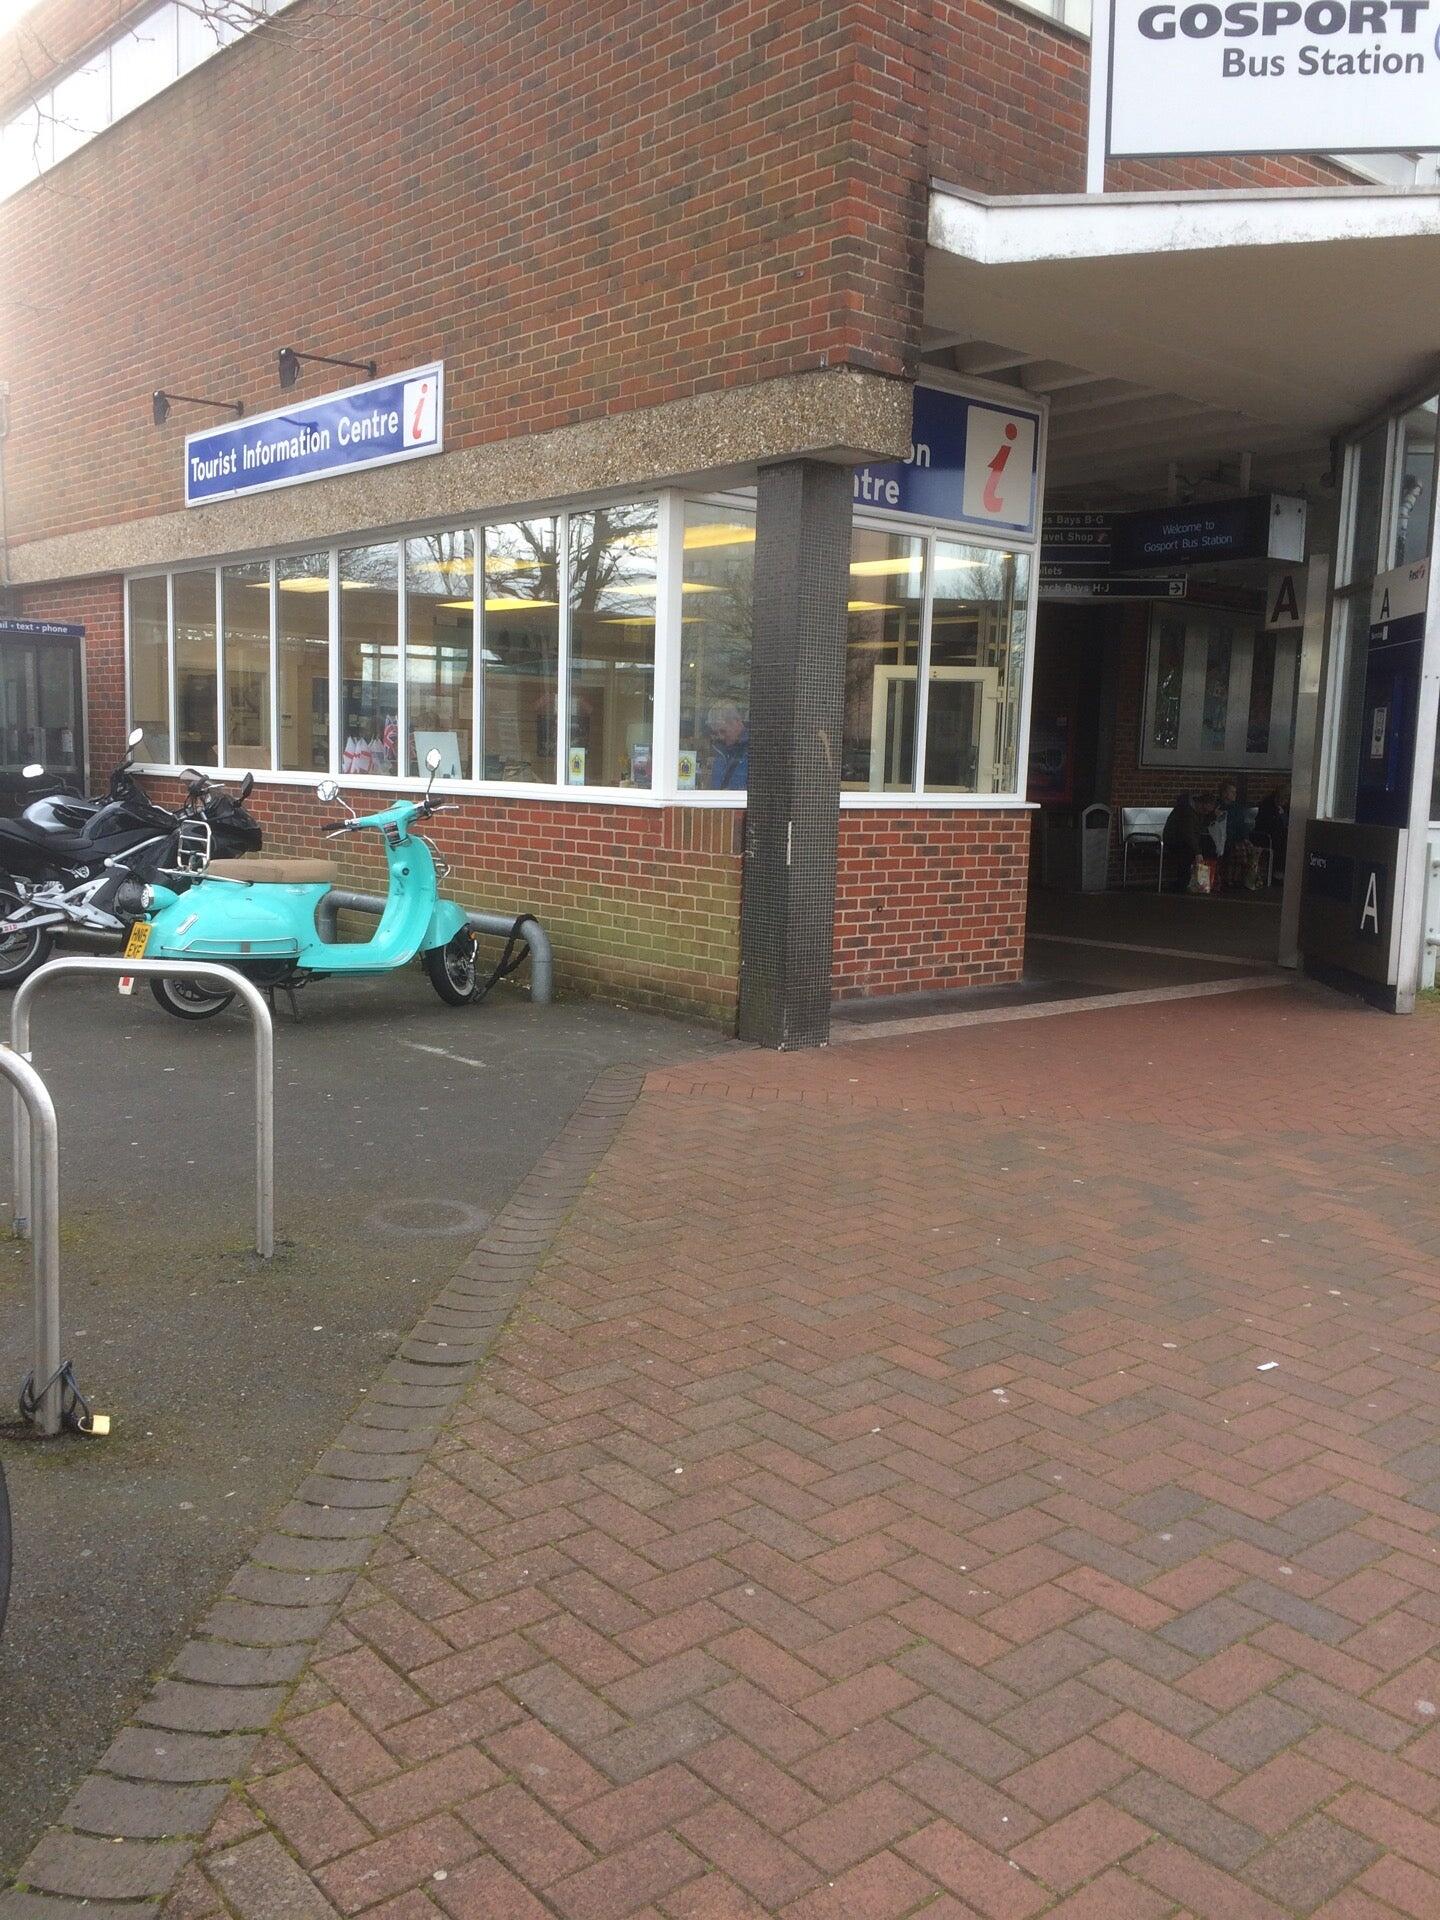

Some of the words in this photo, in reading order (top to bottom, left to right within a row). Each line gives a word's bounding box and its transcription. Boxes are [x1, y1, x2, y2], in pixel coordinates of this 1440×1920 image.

[1138, 0, 1430, 40] GOSPORT
[1222, 47, 1285, 77] Bus
[1298, 44, 1425, 76] Station
[190, 451, 237, 482] Tourist
[243, 427, 330, 470] Information
[338, 410, 399, 447] Centre
[1056, 515, 1081, 526] Bays
[1162, 523, 1202, 535] Welcome
[1205, 521, 1215, 530] to
[1067, 532, 1094, 543] Shop
[1144, 541, 1178, 553] Gosport
[1182, 538, 1198, 549] Bus
[1201, 535, 1233, 547] Station
[1039, 566, 1063, 575] ilets
[1270, 575, 1300, 622] A
[1380, 587, 1390, 620] A
[16, 622, 34, 631] text
[41, 624, 68, 633] phone
[1360, 872, 1379, 934] A
